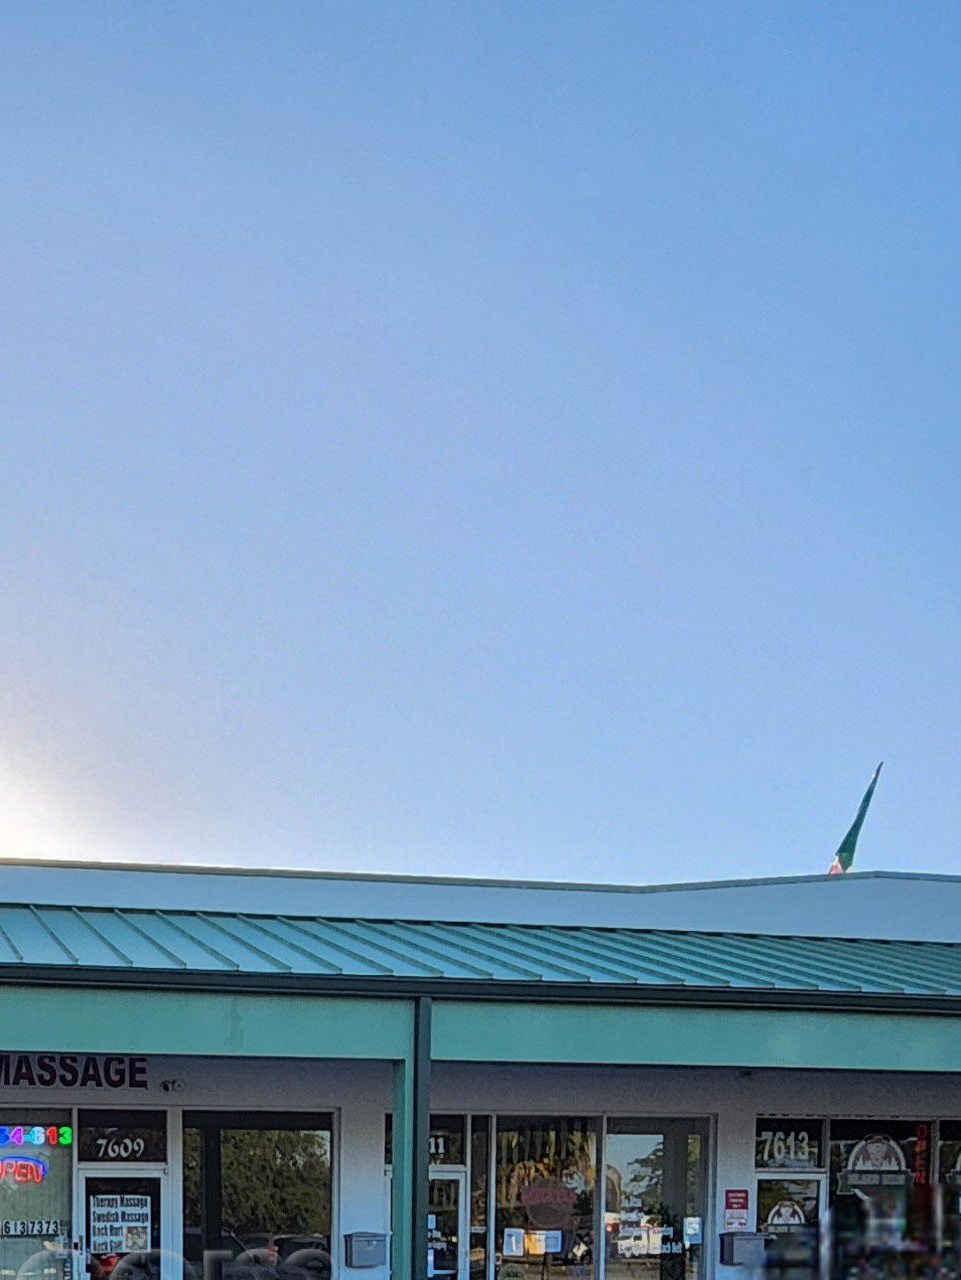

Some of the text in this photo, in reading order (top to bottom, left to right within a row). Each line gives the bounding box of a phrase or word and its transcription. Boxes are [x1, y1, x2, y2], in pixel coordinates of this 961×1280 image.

[96, 1138, 145, 1158] 7609
[429, 1137, 445, 1154] 11
[760, 1131, 810, 1161] 7613
[93, 1211, 149, 1224] Swedish Massage
